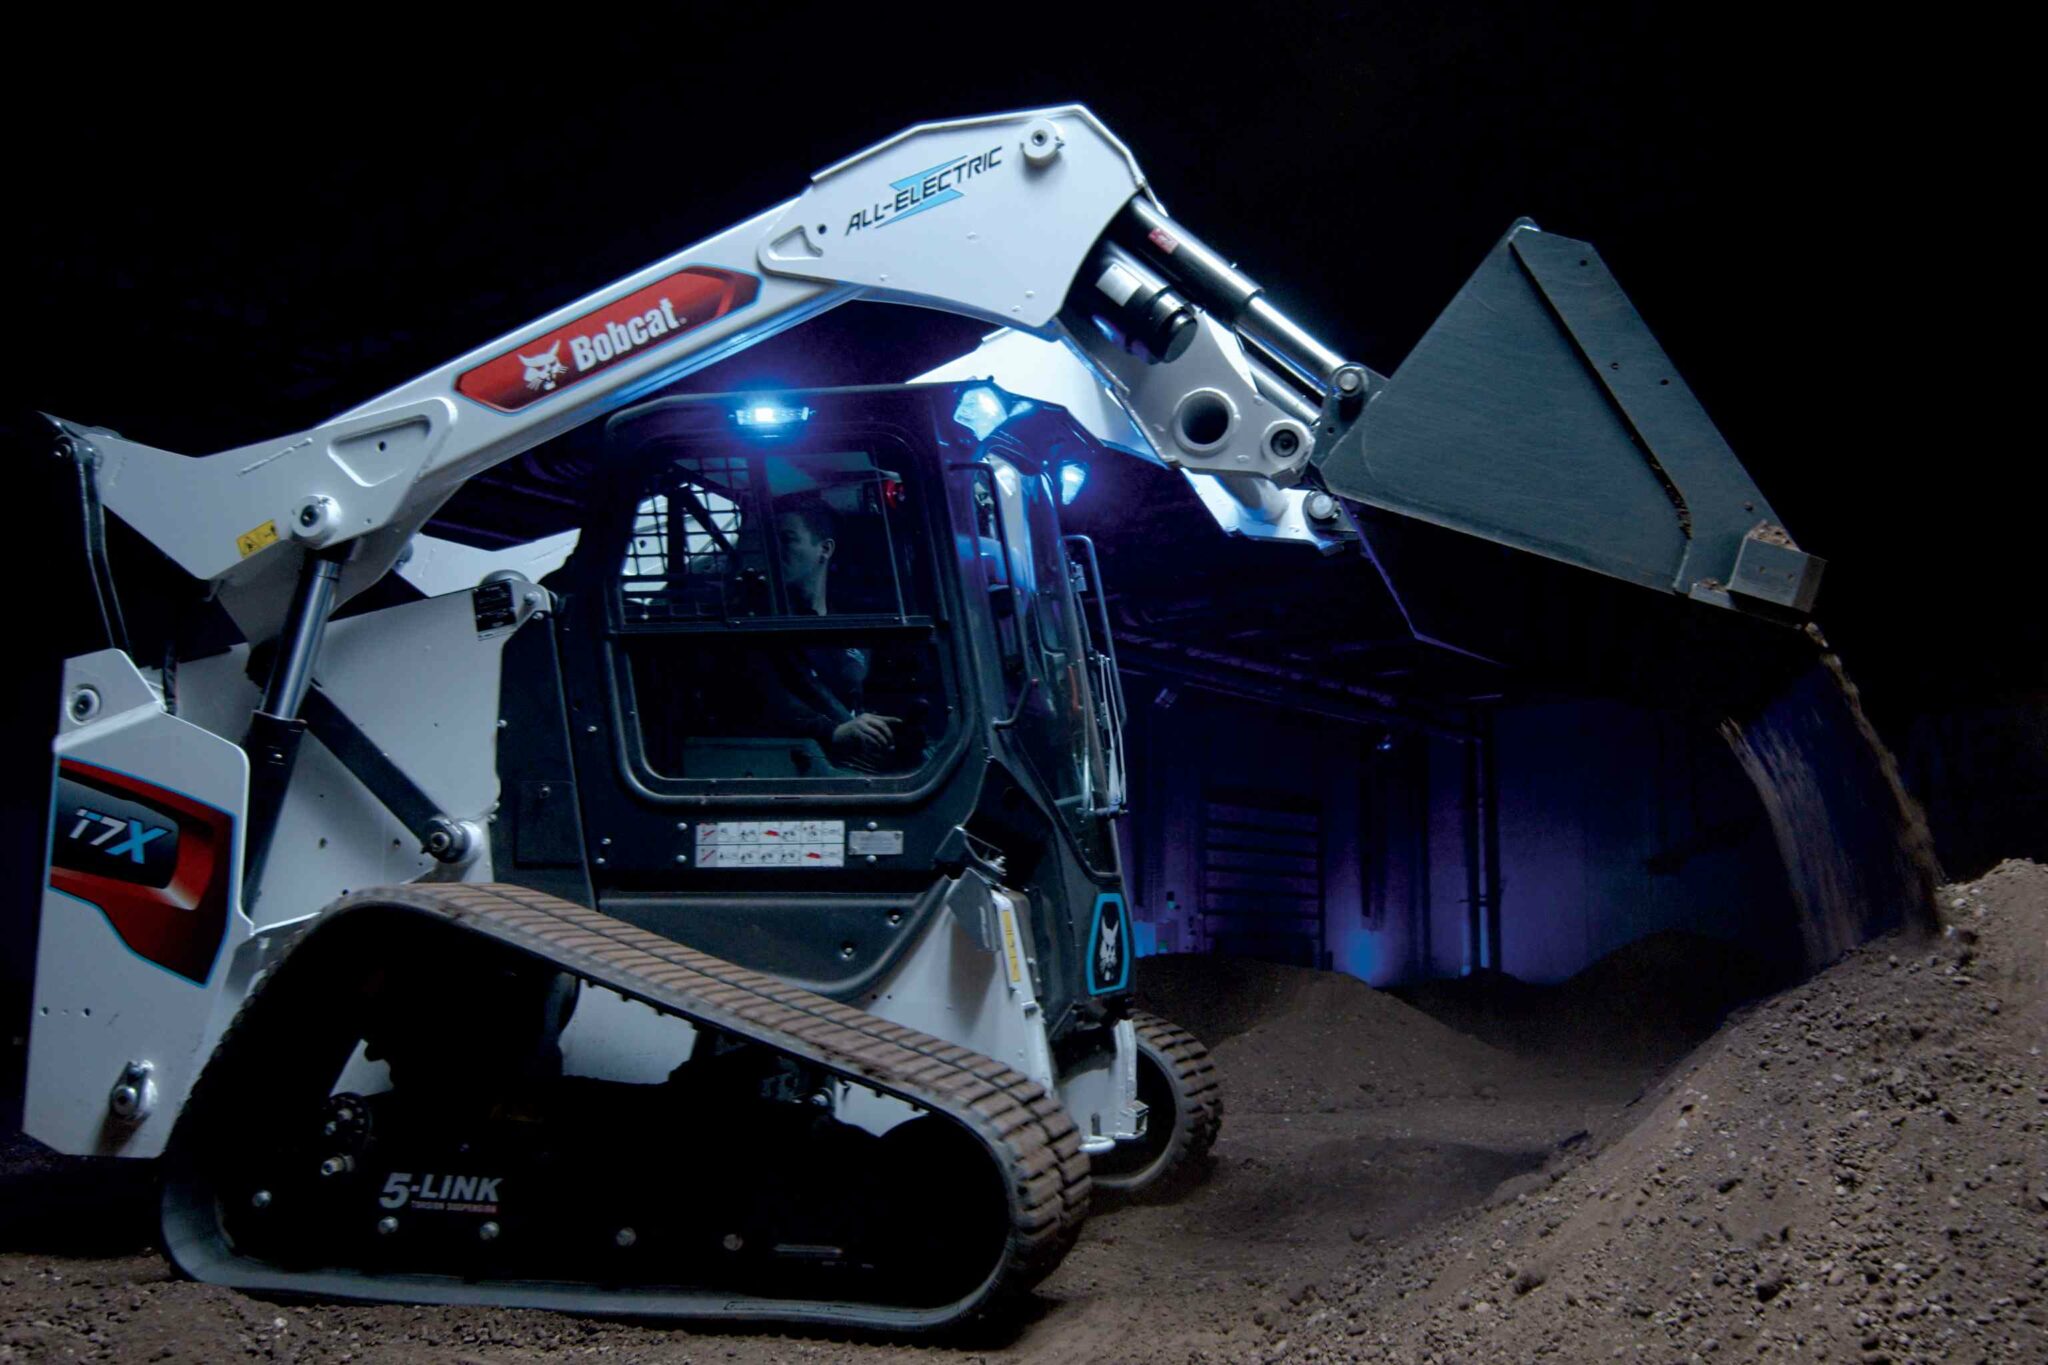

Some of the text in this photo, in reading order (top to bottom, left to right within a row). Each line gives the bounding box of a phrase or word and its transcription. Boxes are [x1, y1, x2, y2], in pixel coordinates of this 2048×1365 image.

[844, 146, 1002, 236] ALL-ELECTRIC
[569, 297, 680, 372] Bobcat
[379, 1172, 503, 1209] 5-LINK
